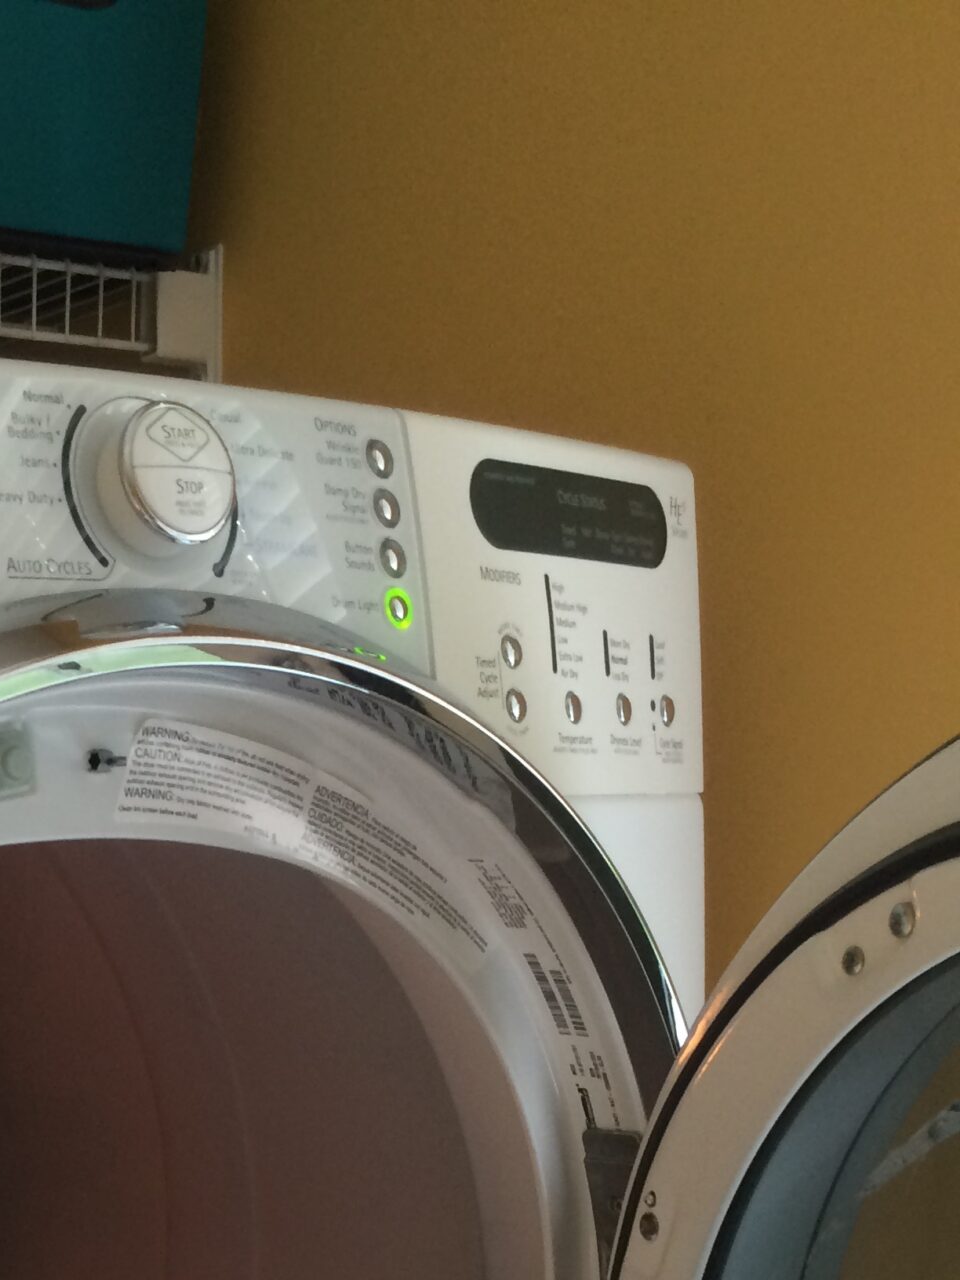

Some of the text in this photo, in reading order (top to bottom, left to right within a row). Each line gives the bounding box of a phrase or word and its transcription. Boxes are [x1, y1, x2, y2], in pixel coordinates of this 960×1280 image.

[22, 390, 65, 405] Normal
[7, 426, 54, 443] Bedding
[161, 424, 196, 440] START
[314, 417, 358, 438] OPTIONS
[176, 478, 204, 495] STOP
[26, 490, 55, 506] Duty
[7, 557, 93, 575] AUTO CYCLES
